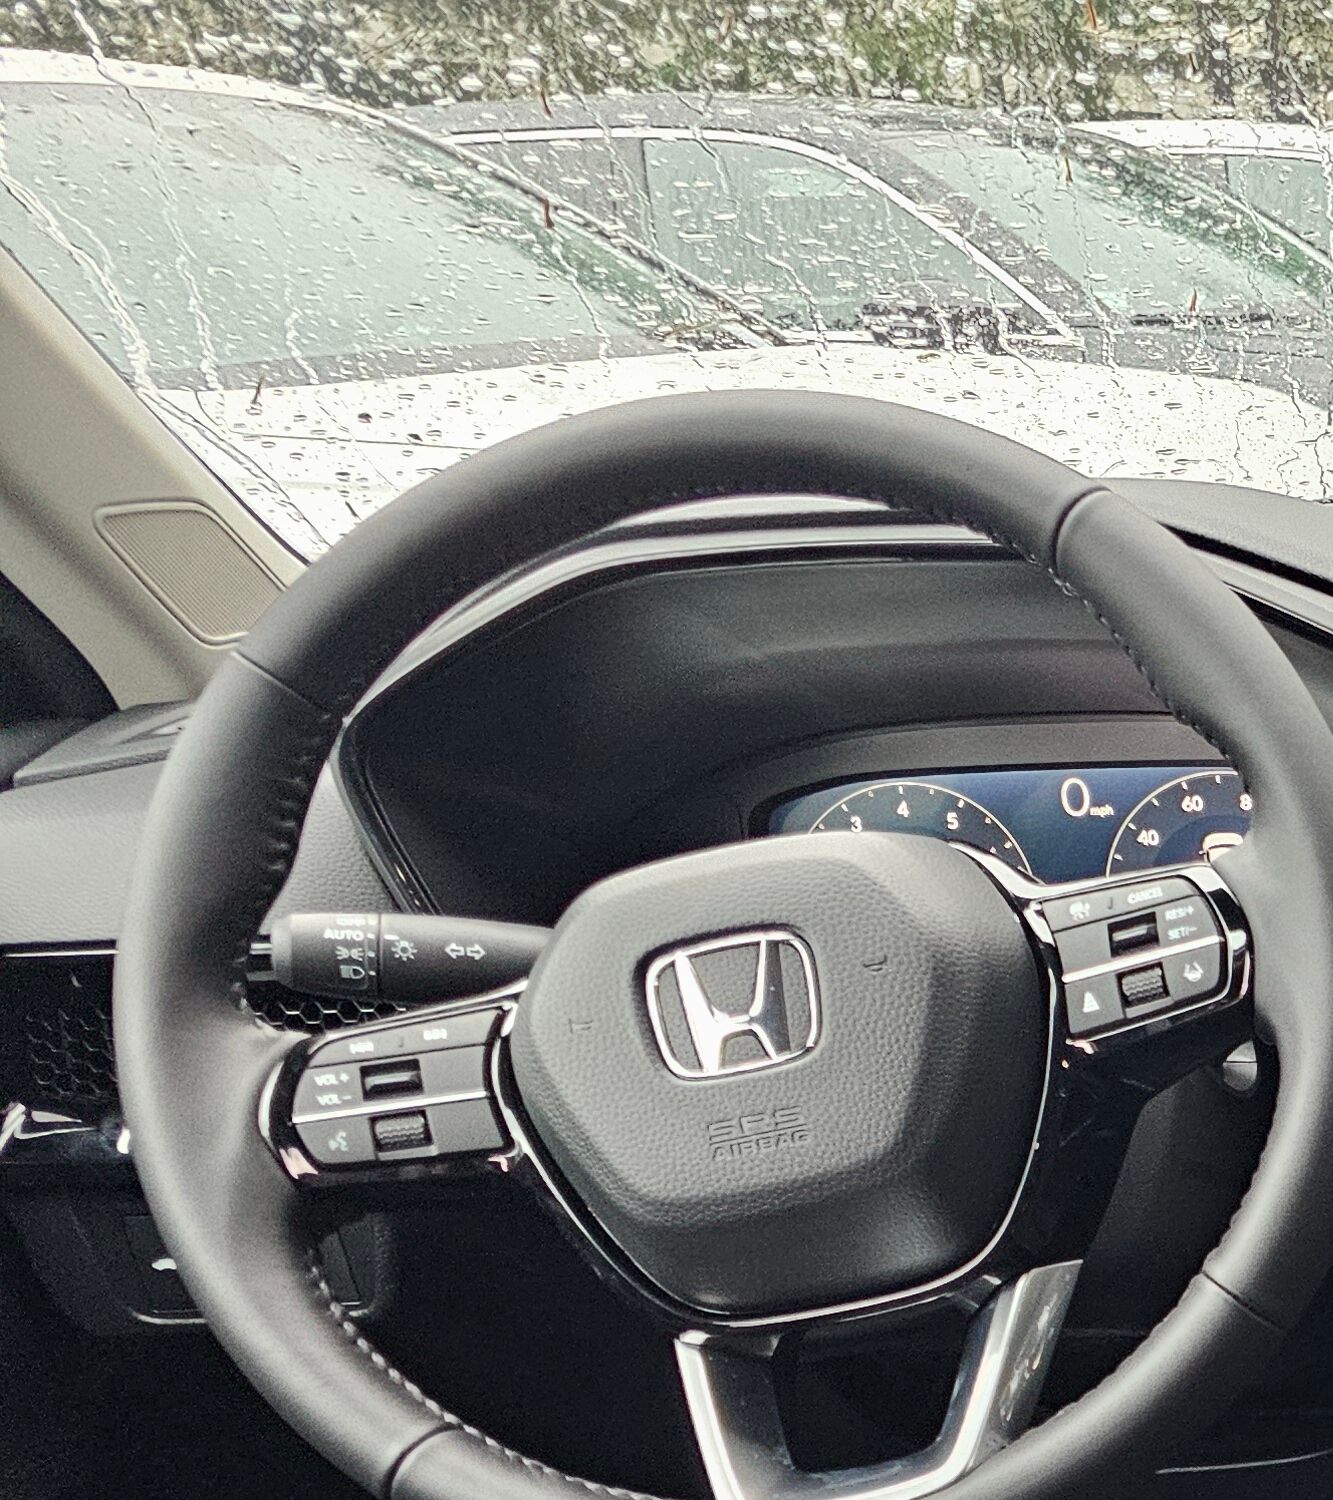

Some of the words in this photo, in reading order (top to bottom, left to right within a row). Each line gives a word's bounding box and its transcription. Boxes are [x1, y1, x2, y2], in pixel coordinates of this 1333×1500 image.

[1061, 777, 1090, 817] 0
[1090, 804, 1114, 818] mph
[1181, 794, 1204, 813] 60
[1239, 794, 1252, 811] 8
[897, 801, 910, 818] 4
[850, 816, 863, 833] 3
[947, 813, 959, 830] 5
[1136, 829, 1160, 847] 40
[324, 928, 364, 941] AUTO
[314, 1074, 338, 1087] VOL
[317, 1094, 341, 1106] VOL
